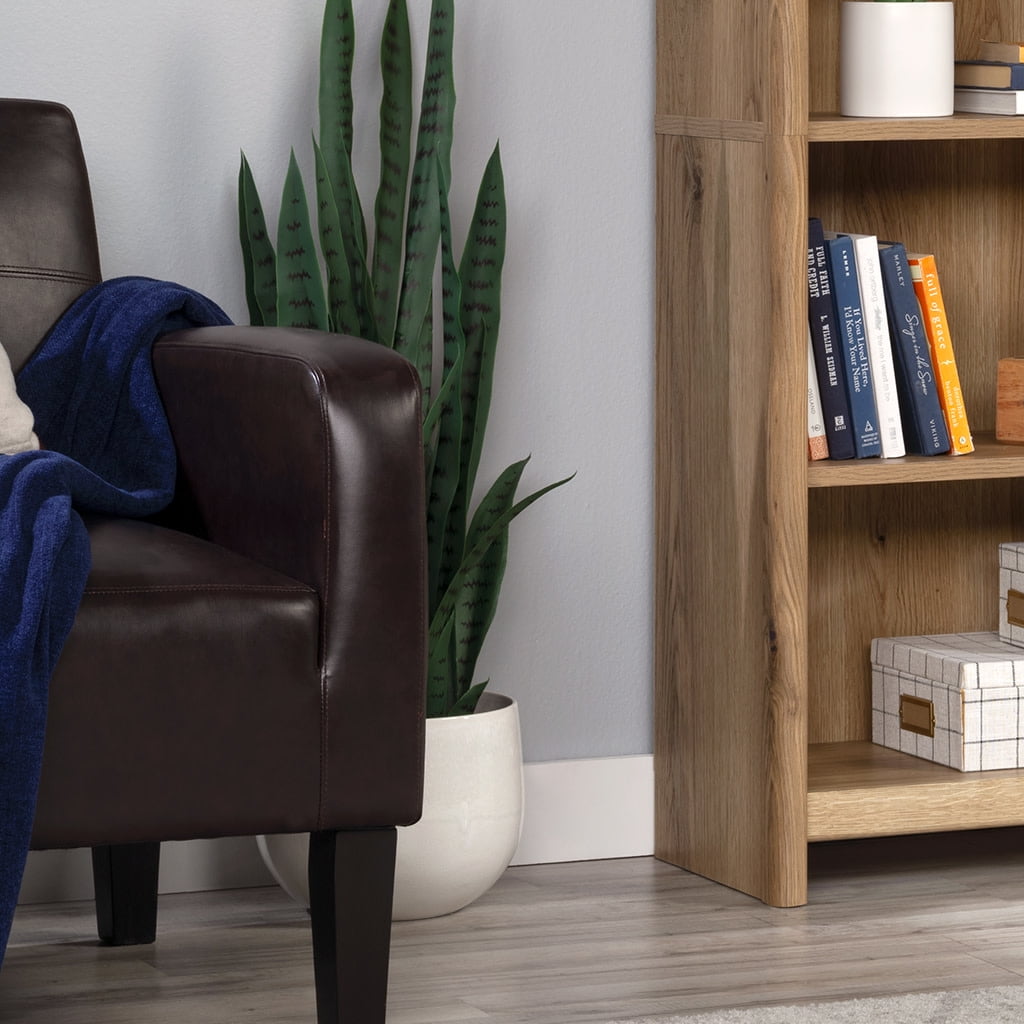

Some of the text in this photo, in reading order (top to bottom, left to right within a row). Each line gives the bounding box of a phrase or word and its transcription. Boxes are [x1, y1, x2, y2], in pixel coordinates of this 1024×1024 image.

[808, 247, 820, 298] AND CREDIT
[815, 246, 831, 296] FULL FAITH
[893, 254, 905, 287] MARLEY
[925, 273, 946, 350] full of grace
[822, 324, 833, 354] WILLIAM
[846, 319, 855, 344] Know
[849, 346, 858, 365] Your
[852, 308, 870, 387] If You Lived Here,
[902, 313, 932, 396] Singer in the Snow
[827, 356, 838, 386] SEIDMAN
[852, 367, 862, 393] Name
[929, 419, 940, 448] VIKING
